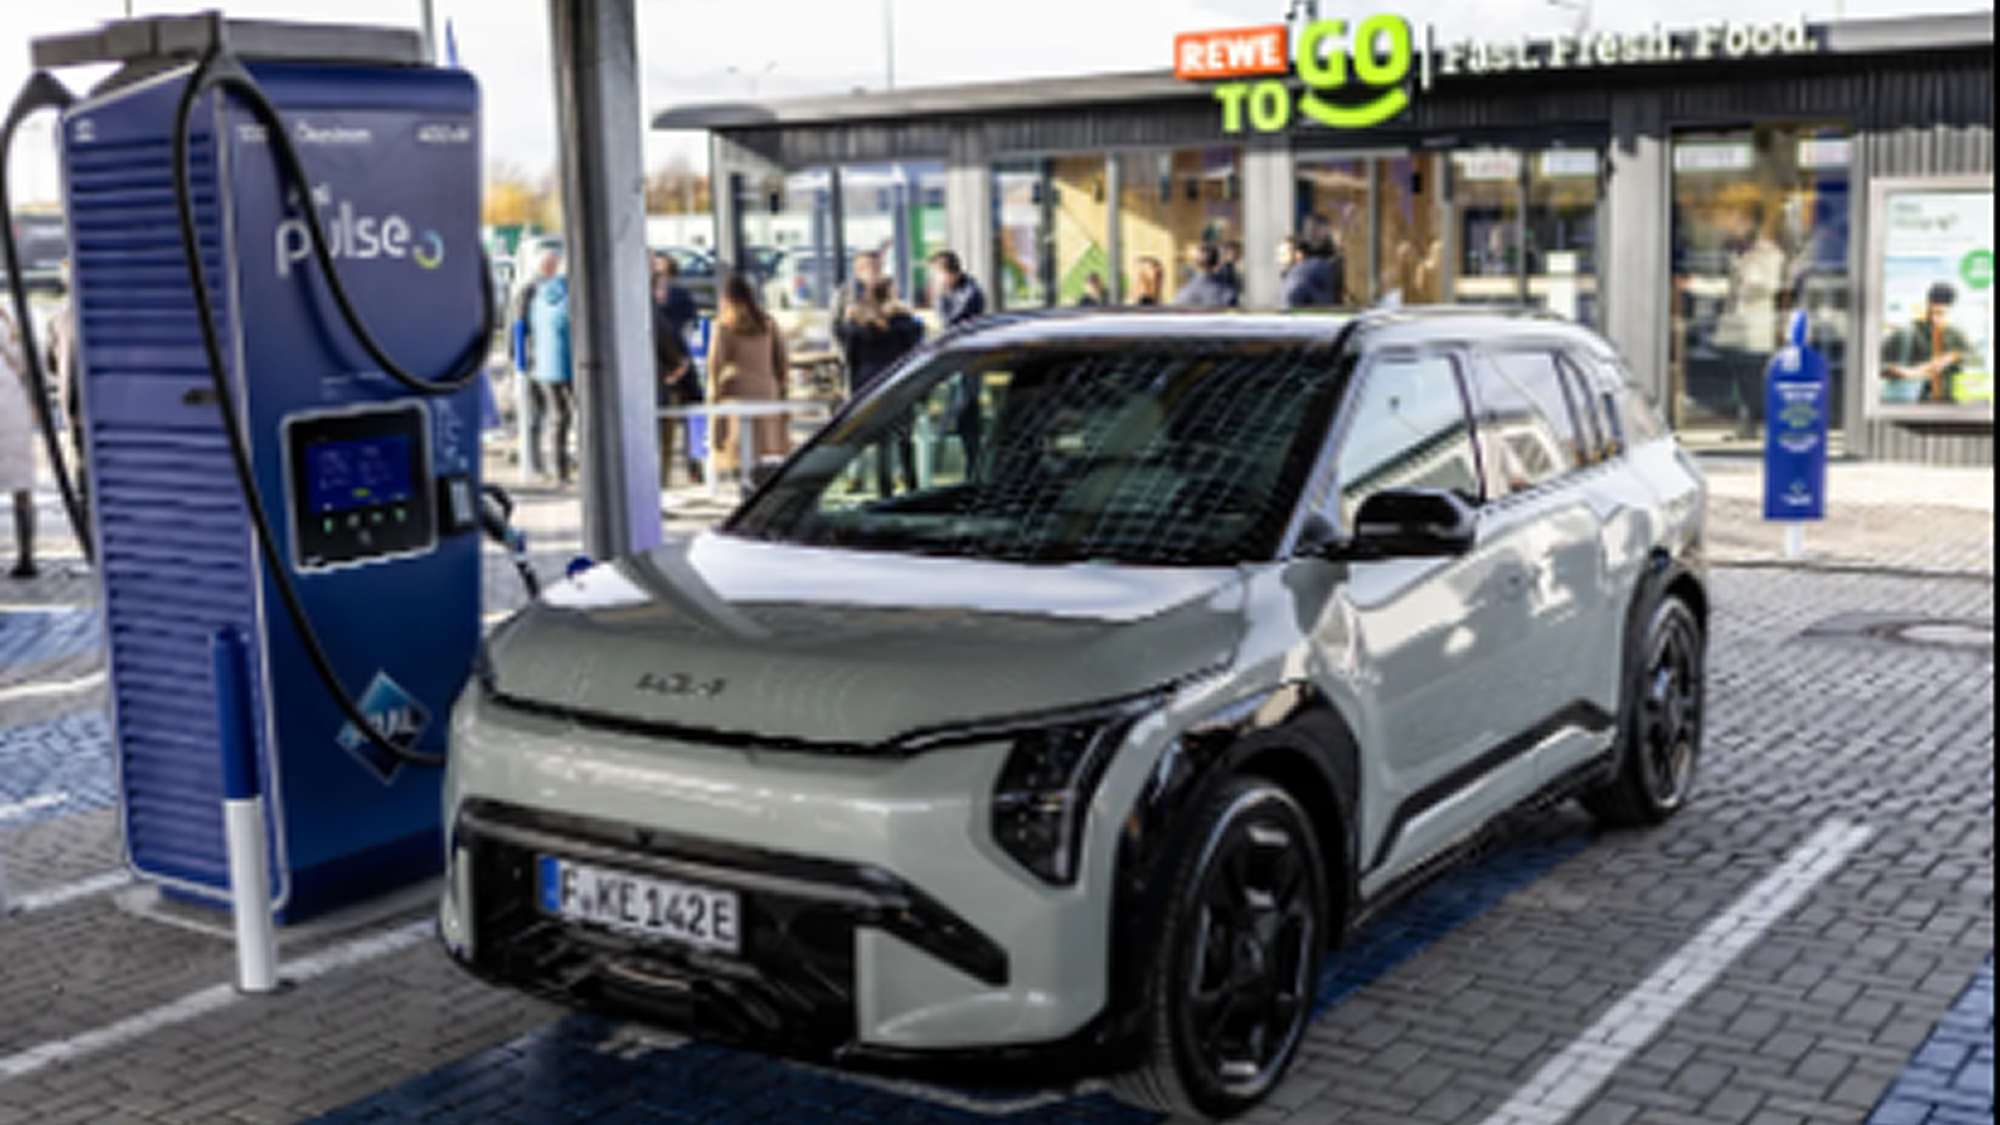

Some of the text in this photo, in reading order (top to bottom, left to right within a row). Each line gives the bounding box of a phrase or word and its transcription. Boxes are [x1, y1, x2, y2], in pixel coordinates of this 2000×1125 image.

[1179, 33, 1281, 73] REWE
[1213, 12, 1413, 133] TO GO
[1439, 19, 1819, 74] Fast. Fresh. Food.
